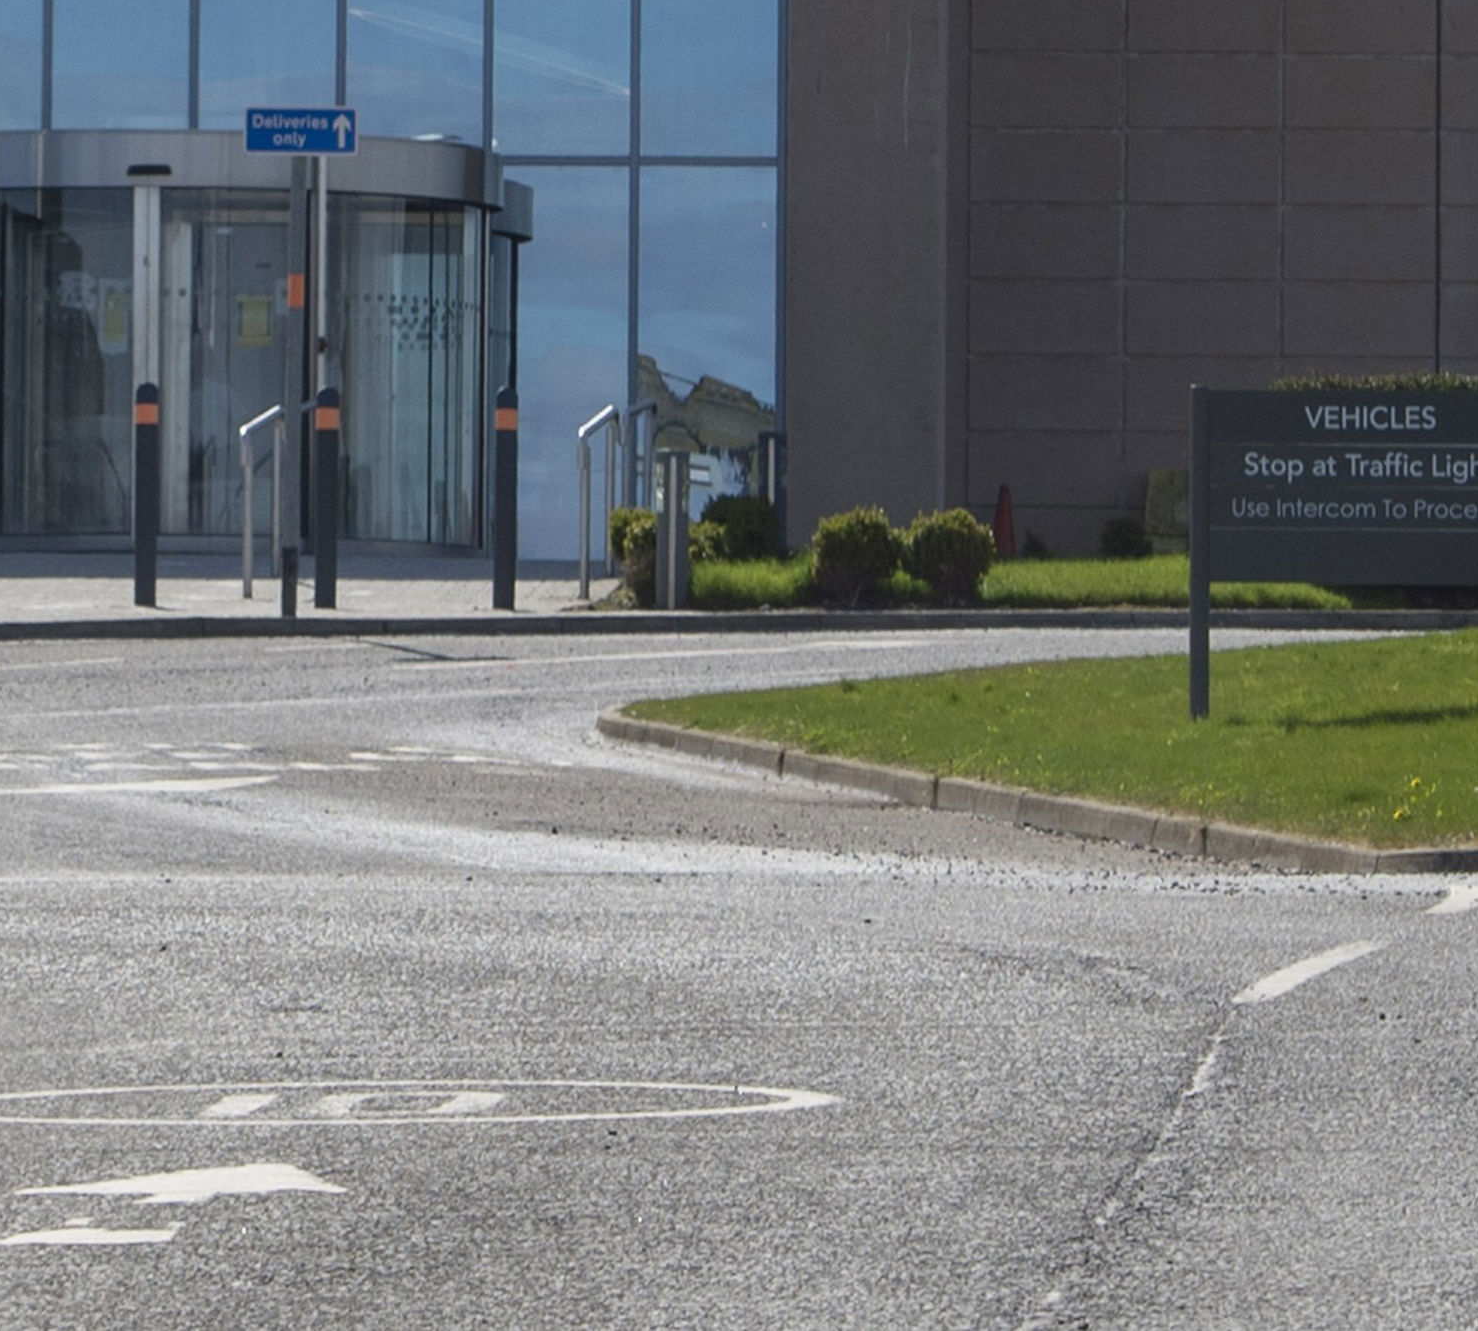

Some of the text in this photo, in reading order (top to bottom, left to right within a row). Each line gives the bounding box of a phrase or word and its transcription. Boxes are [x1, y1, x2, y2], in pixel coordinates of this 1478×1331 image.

[252, 113, 328, 130] Deliveries
[273, 132, 307, 148] only
[1305, 405, 1436, 430] VEHICLES
[1244, 451, 1303, 483] Stop
[1312, 454, 1336, 478] at
[1345, 453, 1422, 478] Traffic
[1232, 497, 1270, 518] Use
[1276, 498, 1376, 519] Intercom
[1383, 498, 1407, 519] To
